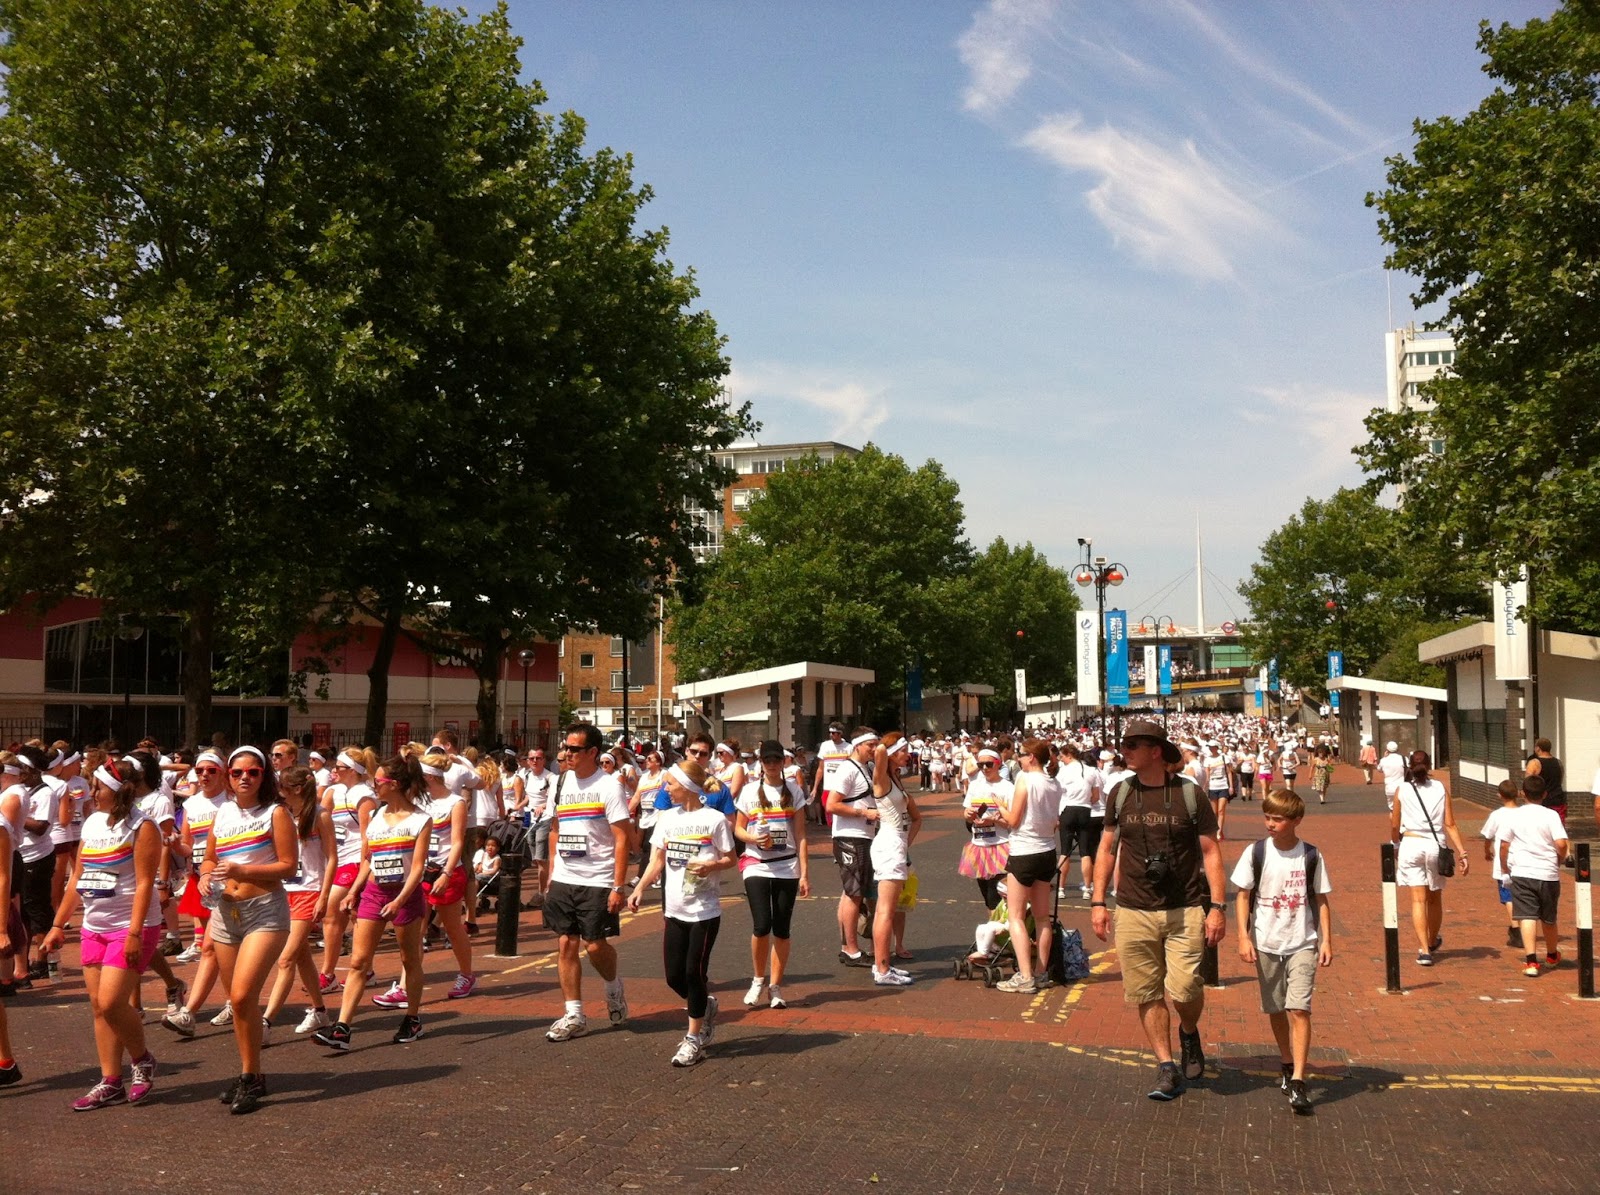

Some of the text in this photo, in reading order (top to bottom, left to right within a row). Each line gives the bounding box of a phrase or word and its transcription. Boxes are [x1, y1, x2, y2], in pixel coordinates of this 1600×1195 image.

[1504, 581, 1517, 636] rclaycard
[565, 793, 586, 804] COLOR
[587, 792, 600, 802] RUN
[396, 828, 411, 837] RUN
[695, 825, 710, 834] RUN
[1284, 880, 1306, 888] PLAY
